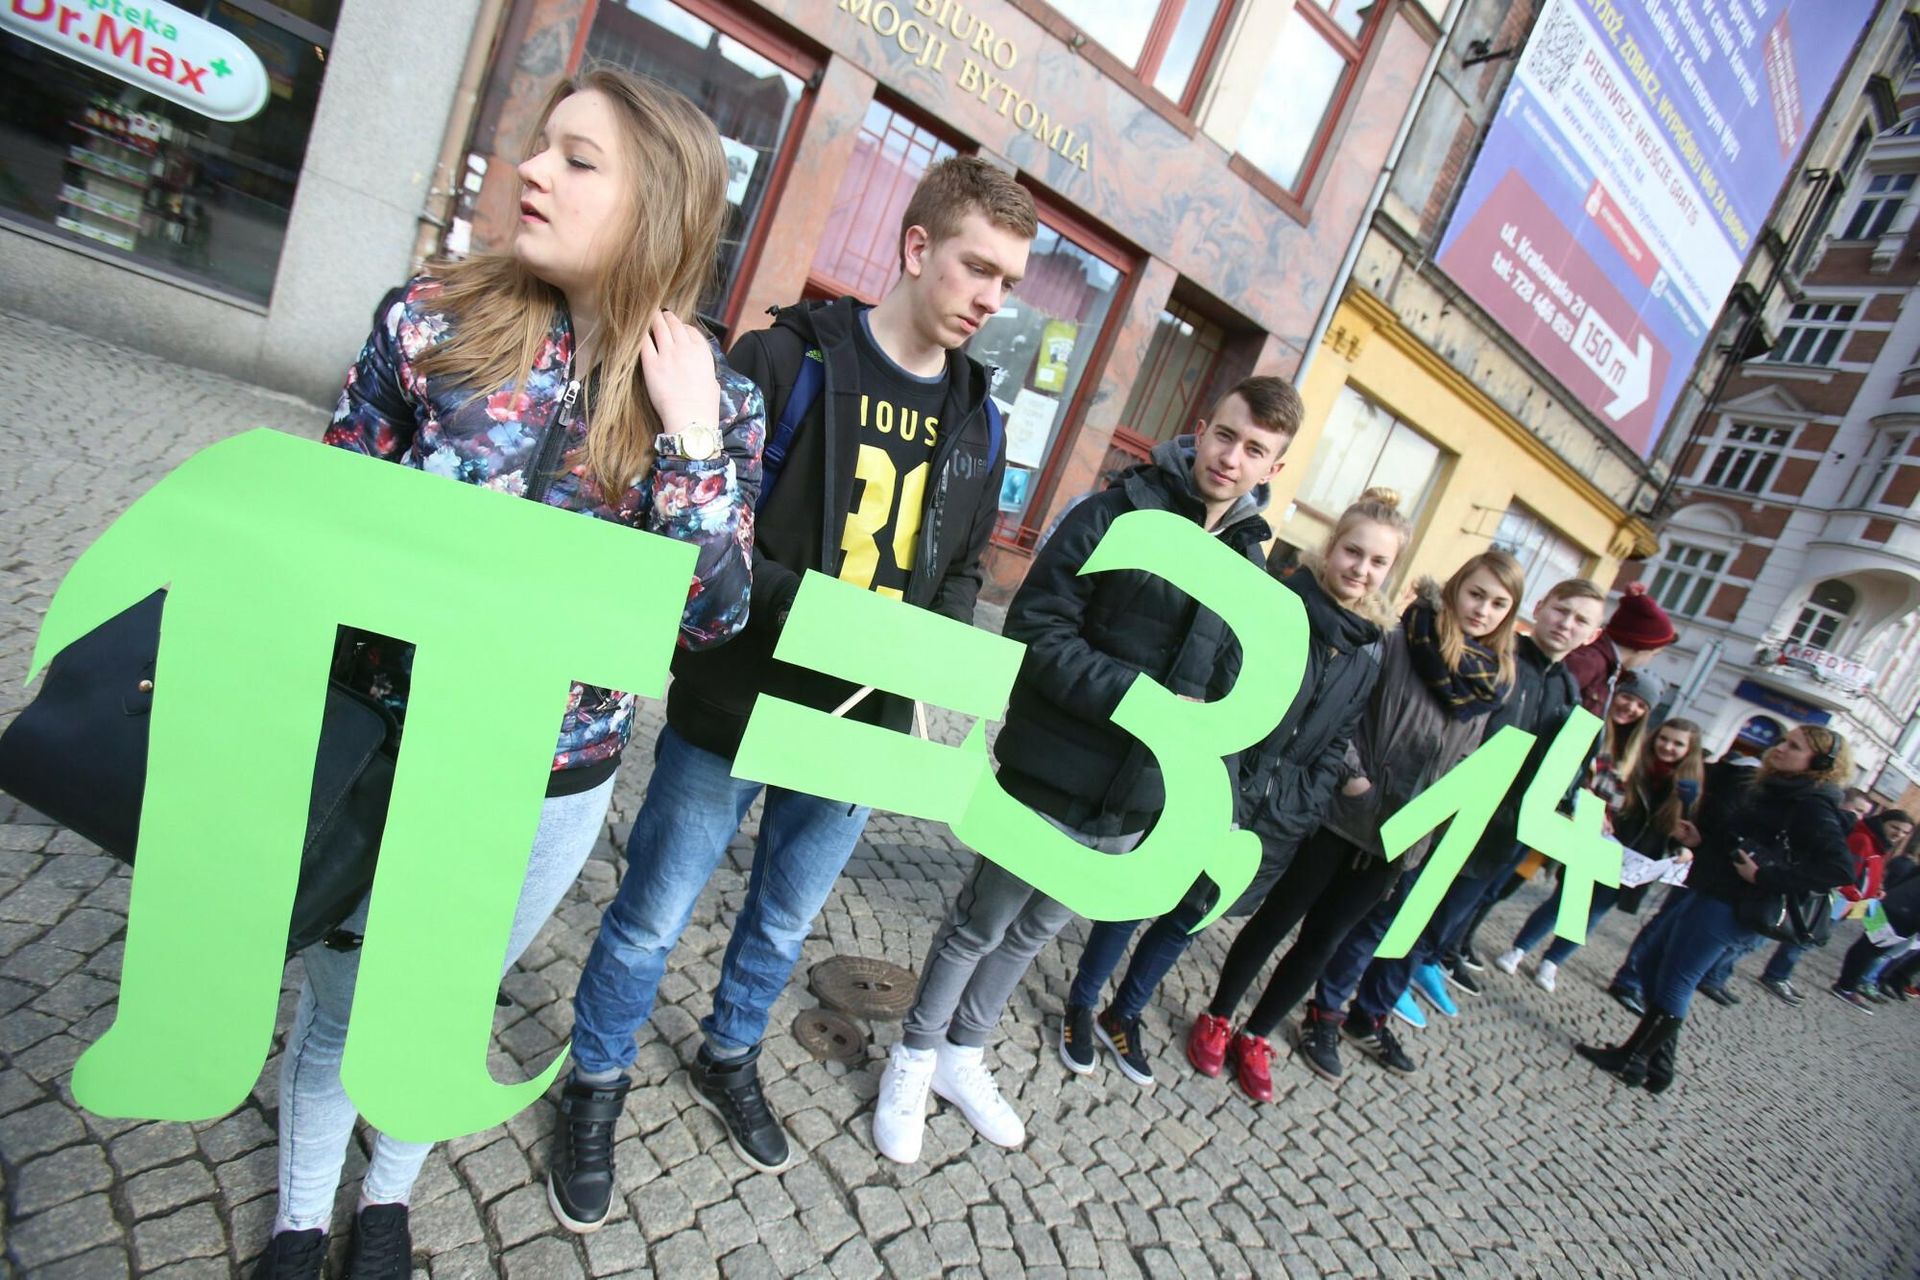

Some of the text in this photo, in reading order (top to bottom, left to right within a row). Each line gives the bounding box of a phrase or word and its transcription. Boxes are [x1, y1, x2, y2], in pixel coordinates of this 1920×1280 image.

[11, 0, 210, 95] Dr.Max
[82, 0, 178, 42] pteka
[913, 0, 1018, 71] BIURO
[956, 56, 1089, 171] BYTOMIA
[1583, 49, 1700, 227] PIERWSZE WEJŚCIE GRATIS
[1500, 222, 1519, 248] ul.
[1516, 236, 1574, 308] Krakowska
[1581, 321, 1627, 385] 150 m
